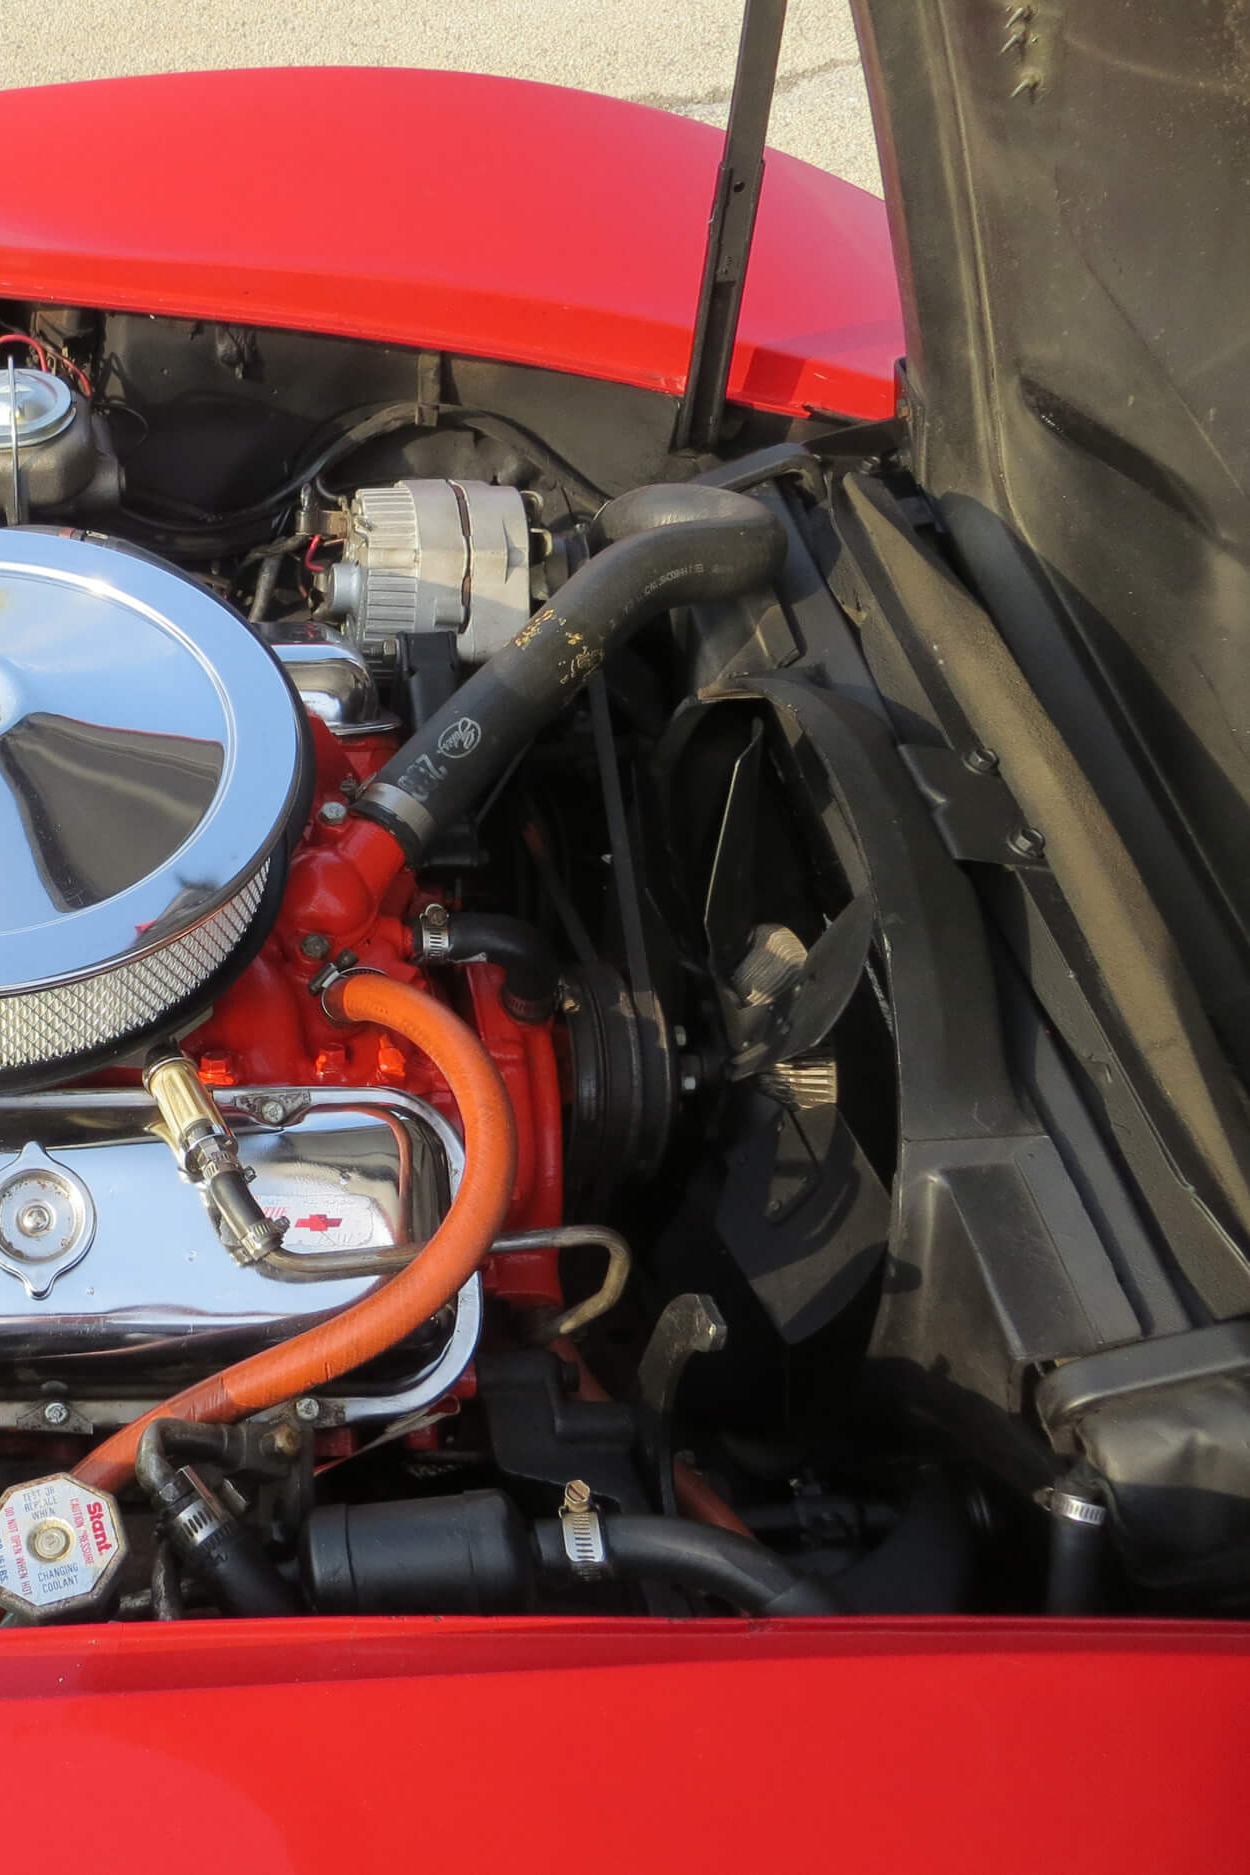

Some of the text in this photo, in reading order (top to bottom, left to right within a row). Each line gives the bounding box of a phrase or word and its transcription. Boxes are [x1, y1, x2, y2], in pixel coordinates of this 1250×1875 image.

[23, 1489, 41, 1502] TEST
[6, 1518, 19, 1532] NOT
[86, 1501, 113, 1553] Stant
[11, 1535, 23, 1555] OPEN
[15, 1557, 29, 1580] WHEN
[37, 1562, 79, 1583] CHANGING
[20, 1581, 33, 1597] HOT
[42, 1575, 79, 1594] COOLANT
